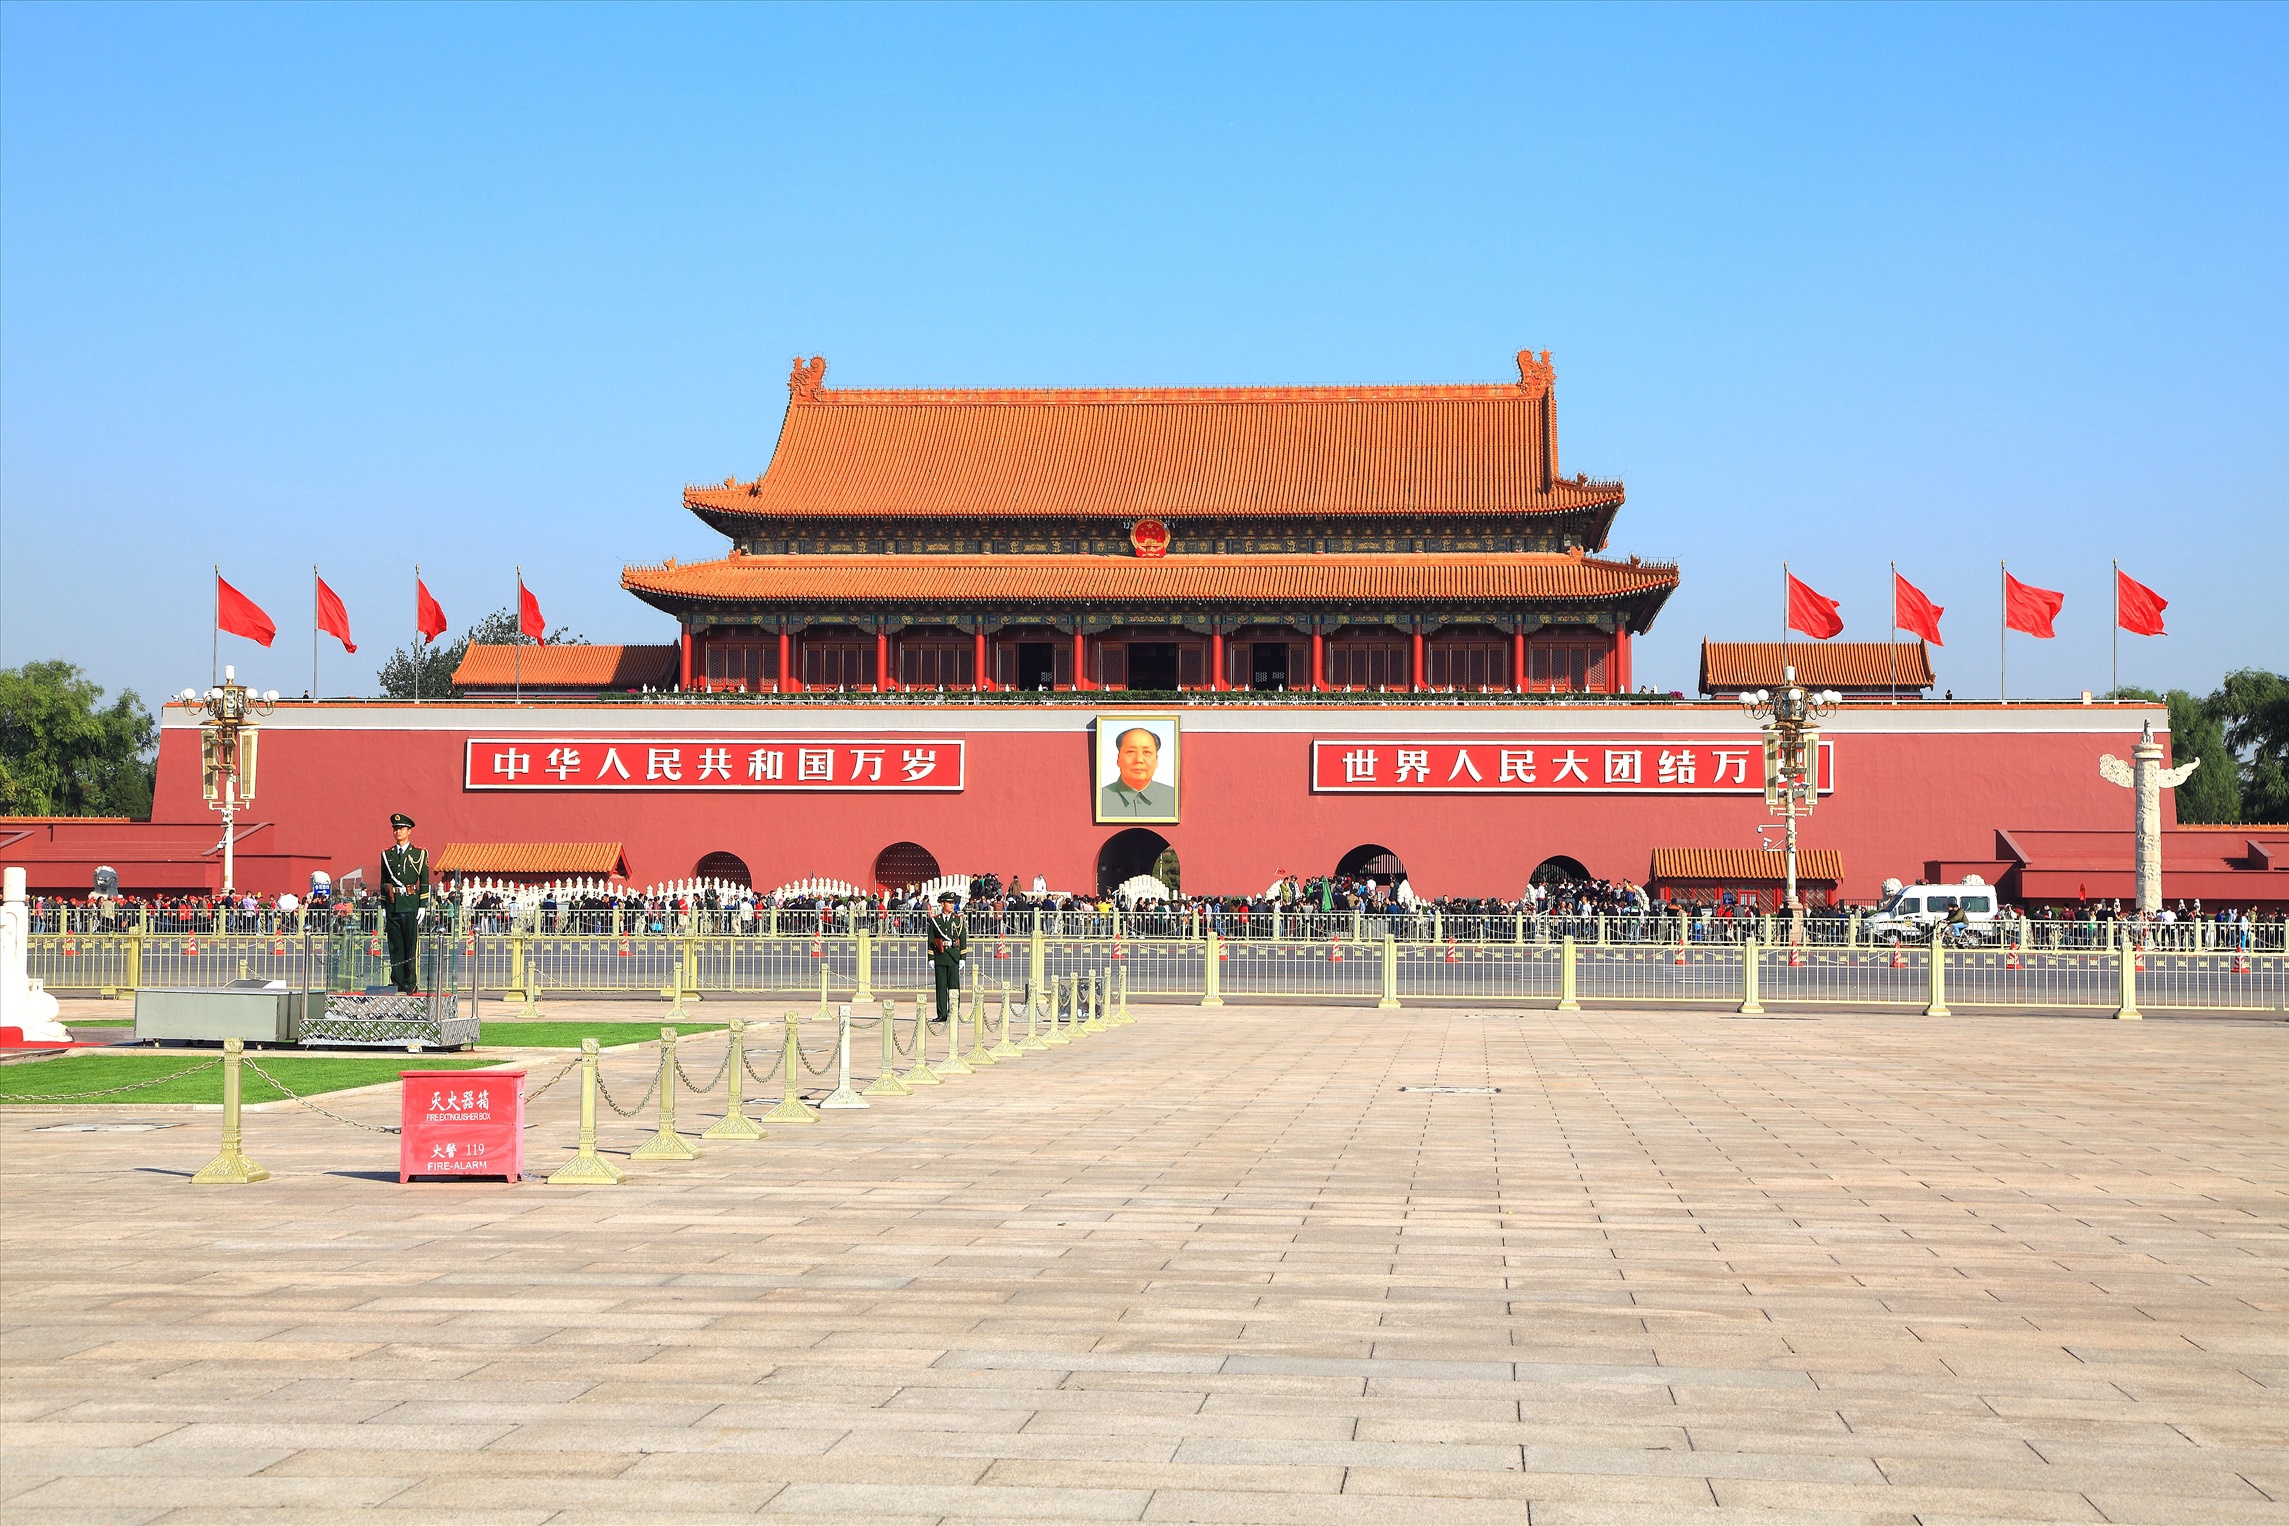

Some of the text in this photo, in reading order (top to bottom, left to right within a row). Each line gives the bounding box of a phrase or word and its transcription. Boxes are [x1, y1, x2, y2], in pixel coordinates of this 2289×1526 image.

[492, 746, 939, 783] 中华人民共和国万岁
[429, 1089, 489, 1111] 灭火器箱
[426, 1112, 491, 1121] FIRE EXTINGUISHER BOX
[431, 1142, 485, 1158] 火警 119
[427, 1160, 487, 1171] FIRE-ALARM
